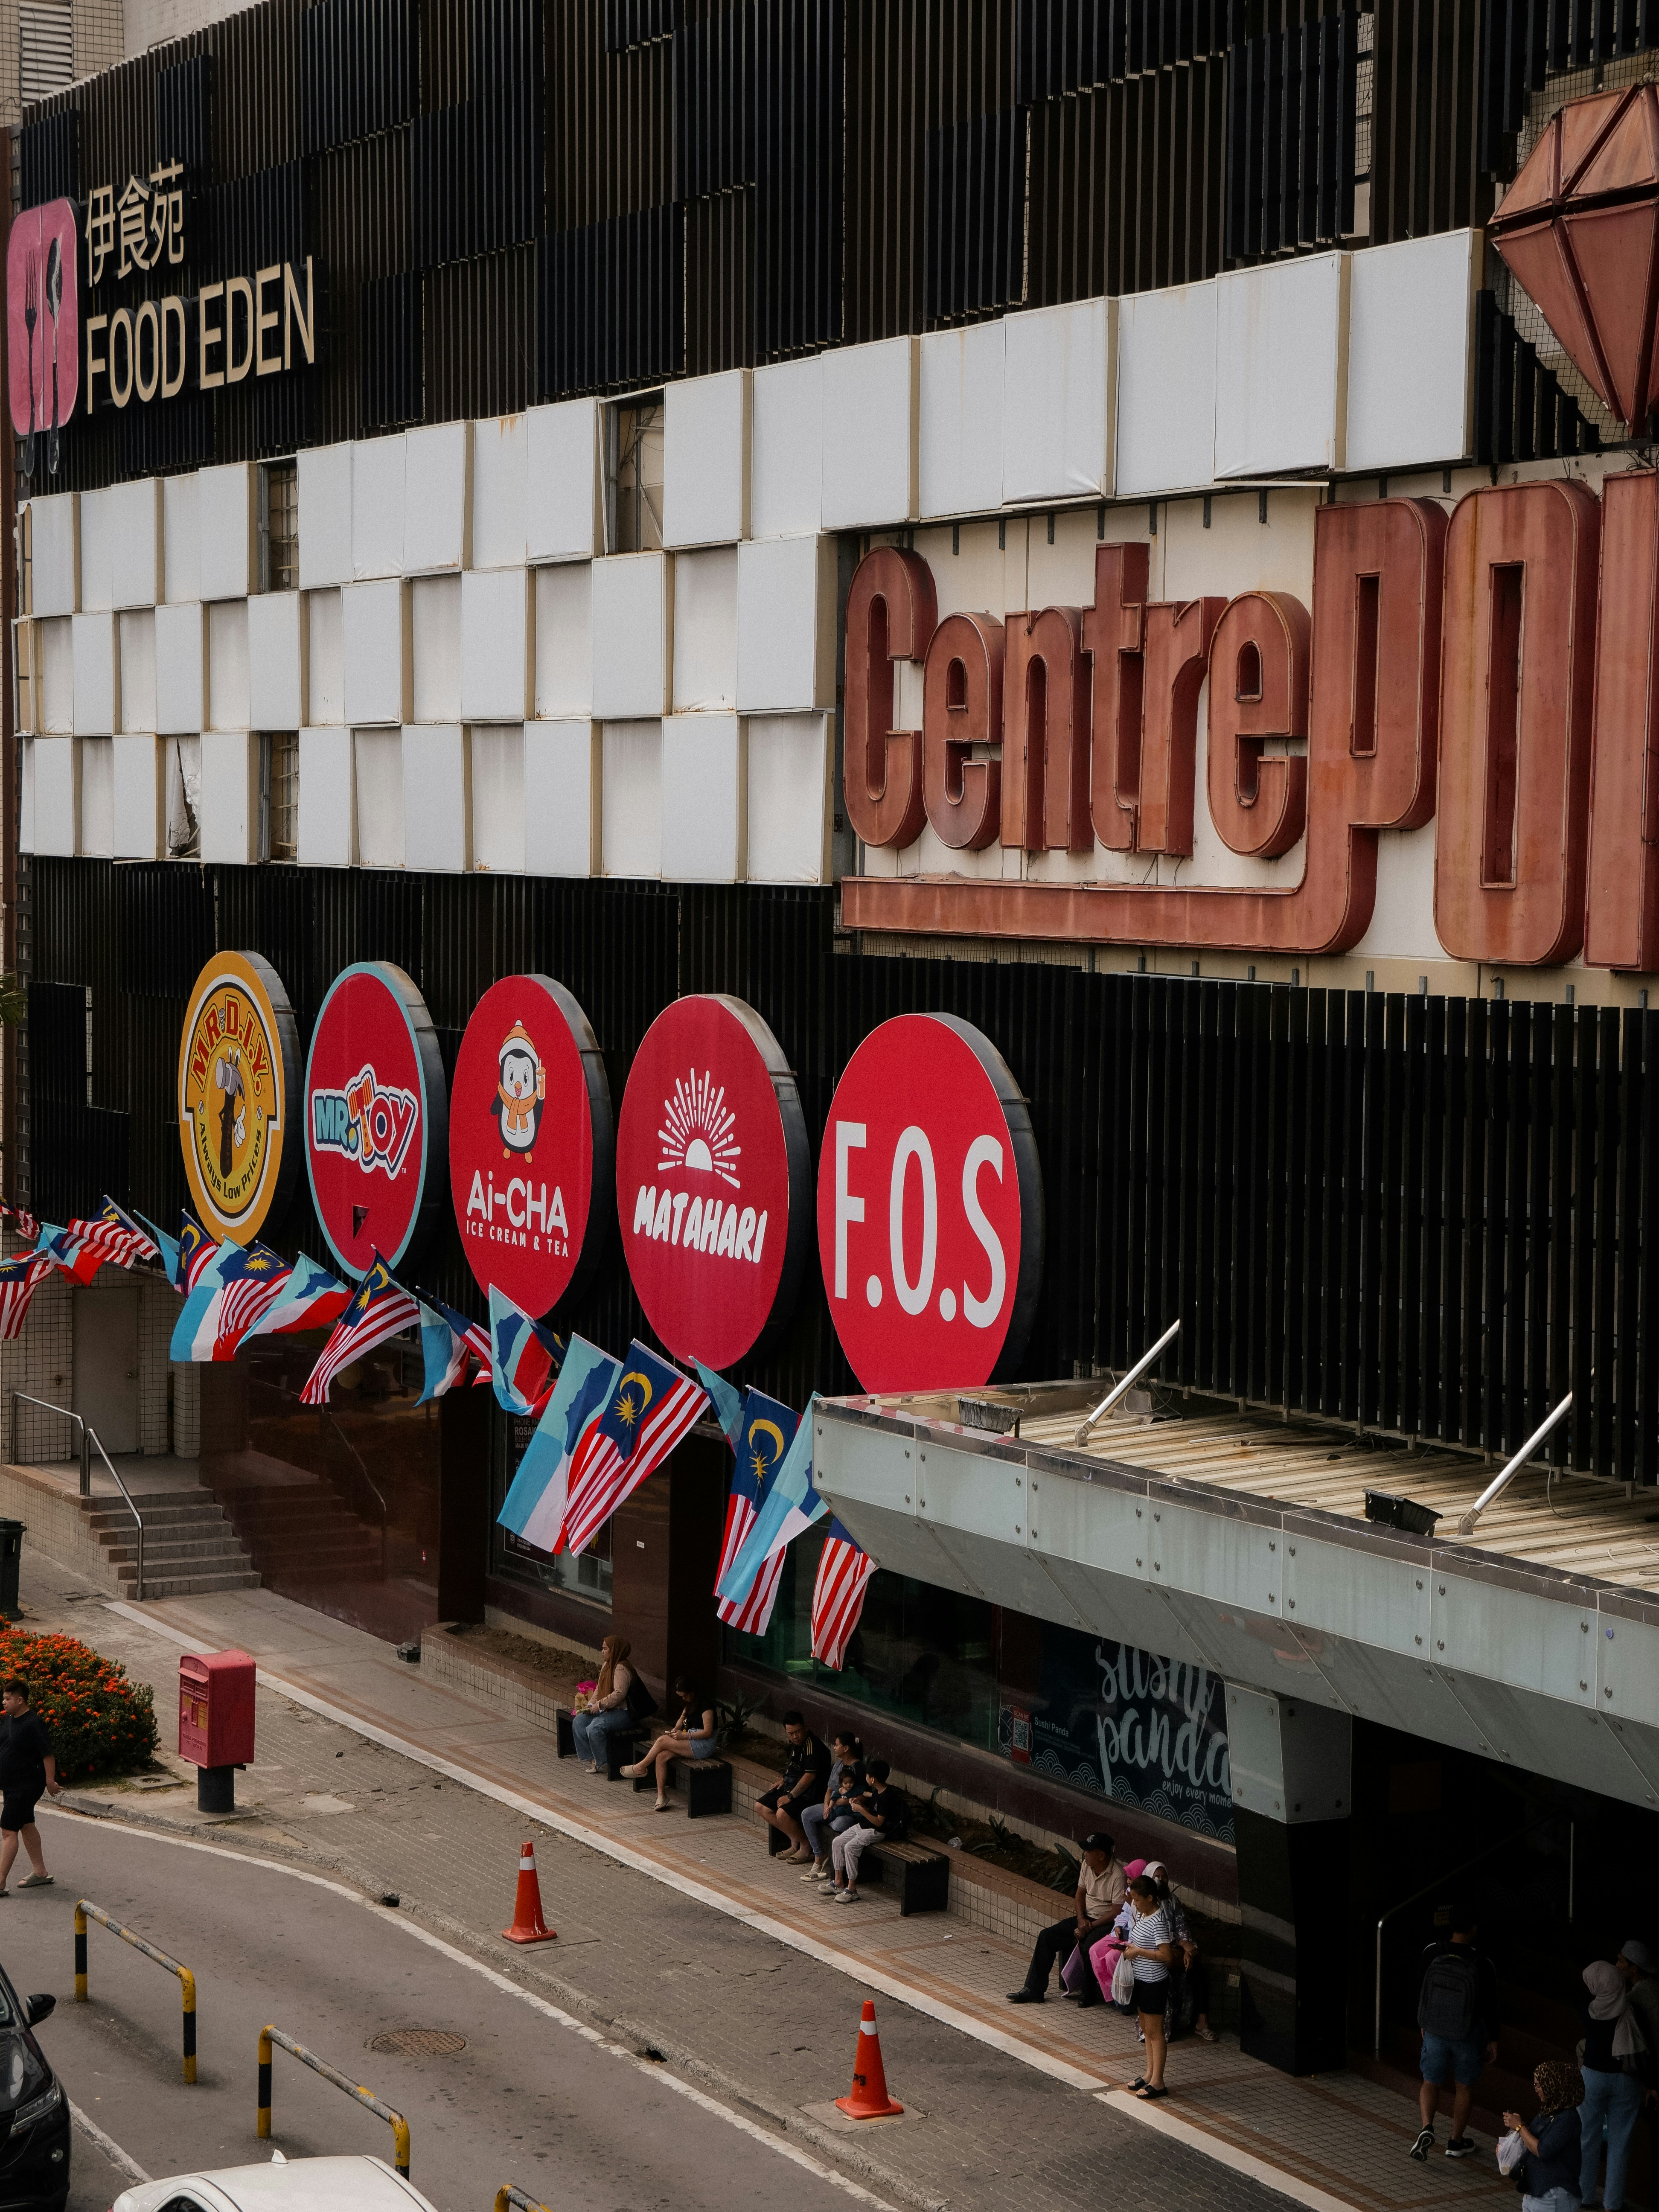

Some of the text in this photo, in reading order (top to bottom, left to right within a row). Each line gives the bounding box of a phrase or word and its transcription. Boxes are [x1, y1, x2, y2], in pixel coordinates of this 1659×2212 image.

[85, 157, 184, 288] 伊食苑
[87, 255, 314, 415] FOOD EDEN
[199, 1122, 261, 1199] Always Low Prices
[466, 1220, 569, 1257] ICE CREAM & TEA
[467, 1170, 569, 1238] Ai-CHA
[633, 1185, 768, 1263] MATAHARI
[835, 1120, 1006, 1329] F.O.S
[1035, 1717, 1050, 1730] Sushi
[1051, 1723, 1069, 1738] Panda
[1096, 1707, 1232, 1796] panda
[1162, 1780, 1183, 1799] enjoy
[1186, 1787, 1207, 1805] every
